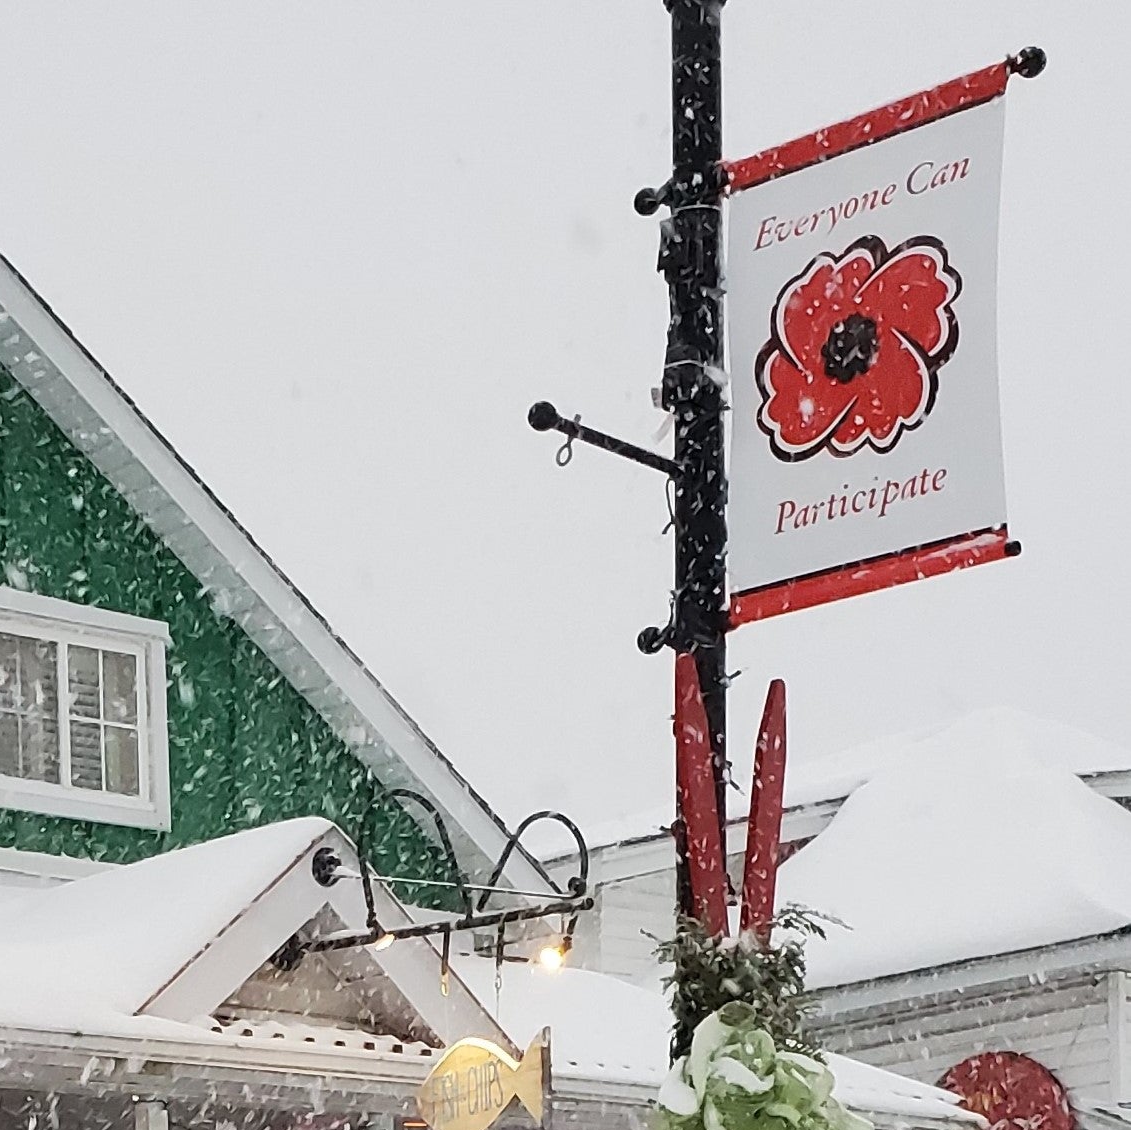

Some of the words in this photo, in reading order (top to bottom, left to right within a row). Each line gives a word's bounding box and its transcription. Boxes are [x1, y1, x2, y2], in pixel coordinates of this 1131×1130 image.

[753, 184, 897, 251] Everyone
[906, 157, 970, 195] Can
[774, 468, 947, 535] Participate
[467, 1058, 504, 1115] CHIPS
